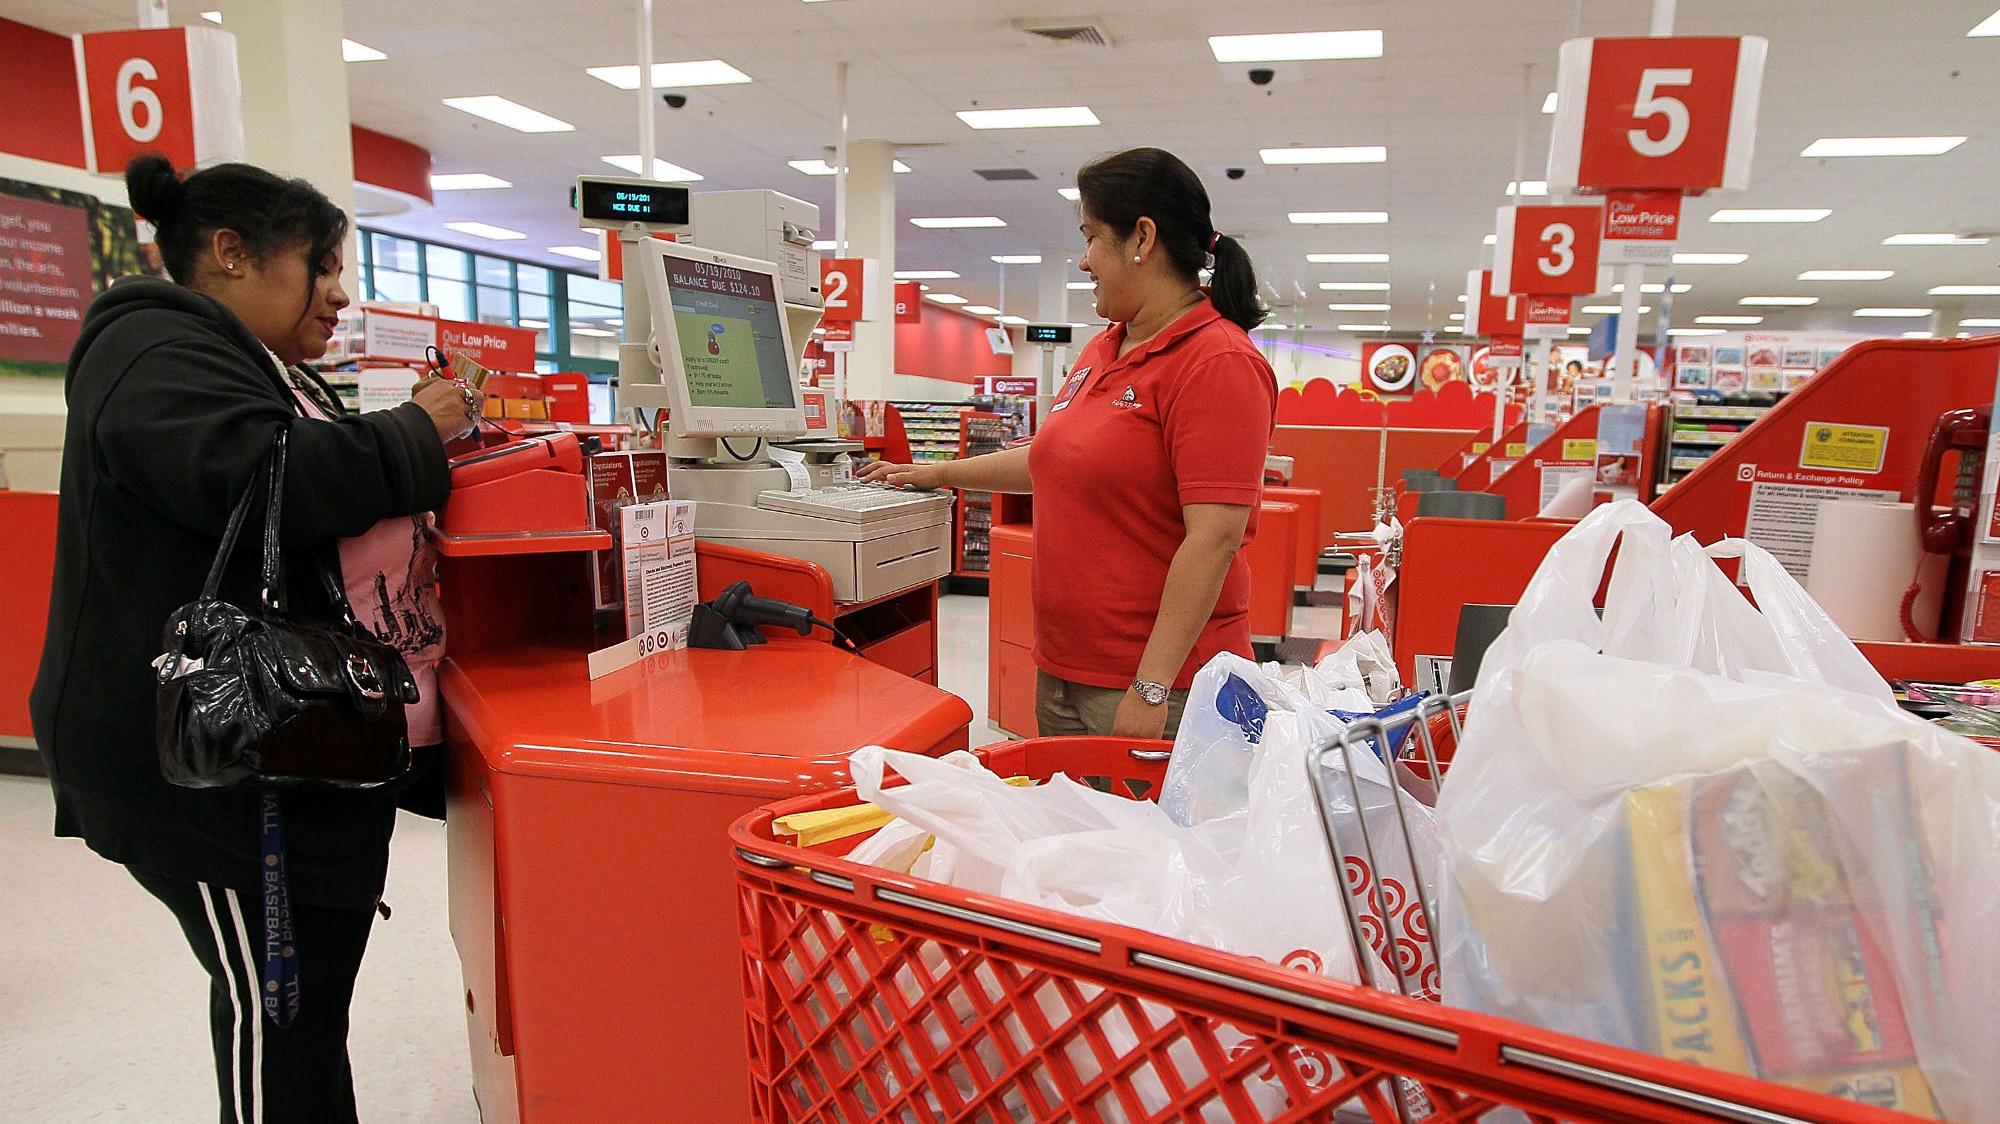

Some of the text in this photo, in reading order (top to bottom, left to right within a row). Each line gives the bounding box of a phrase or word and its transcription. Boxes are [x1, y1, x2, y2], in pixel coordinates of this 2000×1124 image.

[116, 57, 164, 142] 6
[1627, 68, 1693, 157] 5
[1610, 200, 1634, 212] Our
[1608, 222, 1664, 235] Promise
[1609, 211, 1675, 225] Low Price
[1537, 222, 1575, 276] 3
[694, 262, 741, 280] 05/19/2010
[673, 274, 760, 297] BALANCE DUE $124.10
[824, 271, 848, 308] 2
[442, 329, 460, 343] Our
[462, 332, 482, 346] Low
[484, 334, 507, 350] Price
[1757, 470, 1785, 480] Return
[1796, 472, 1836, 484] Exchange
[1838, 475, 1865, 486] Policy
[264, 871, 280, 962] BASEBALL
